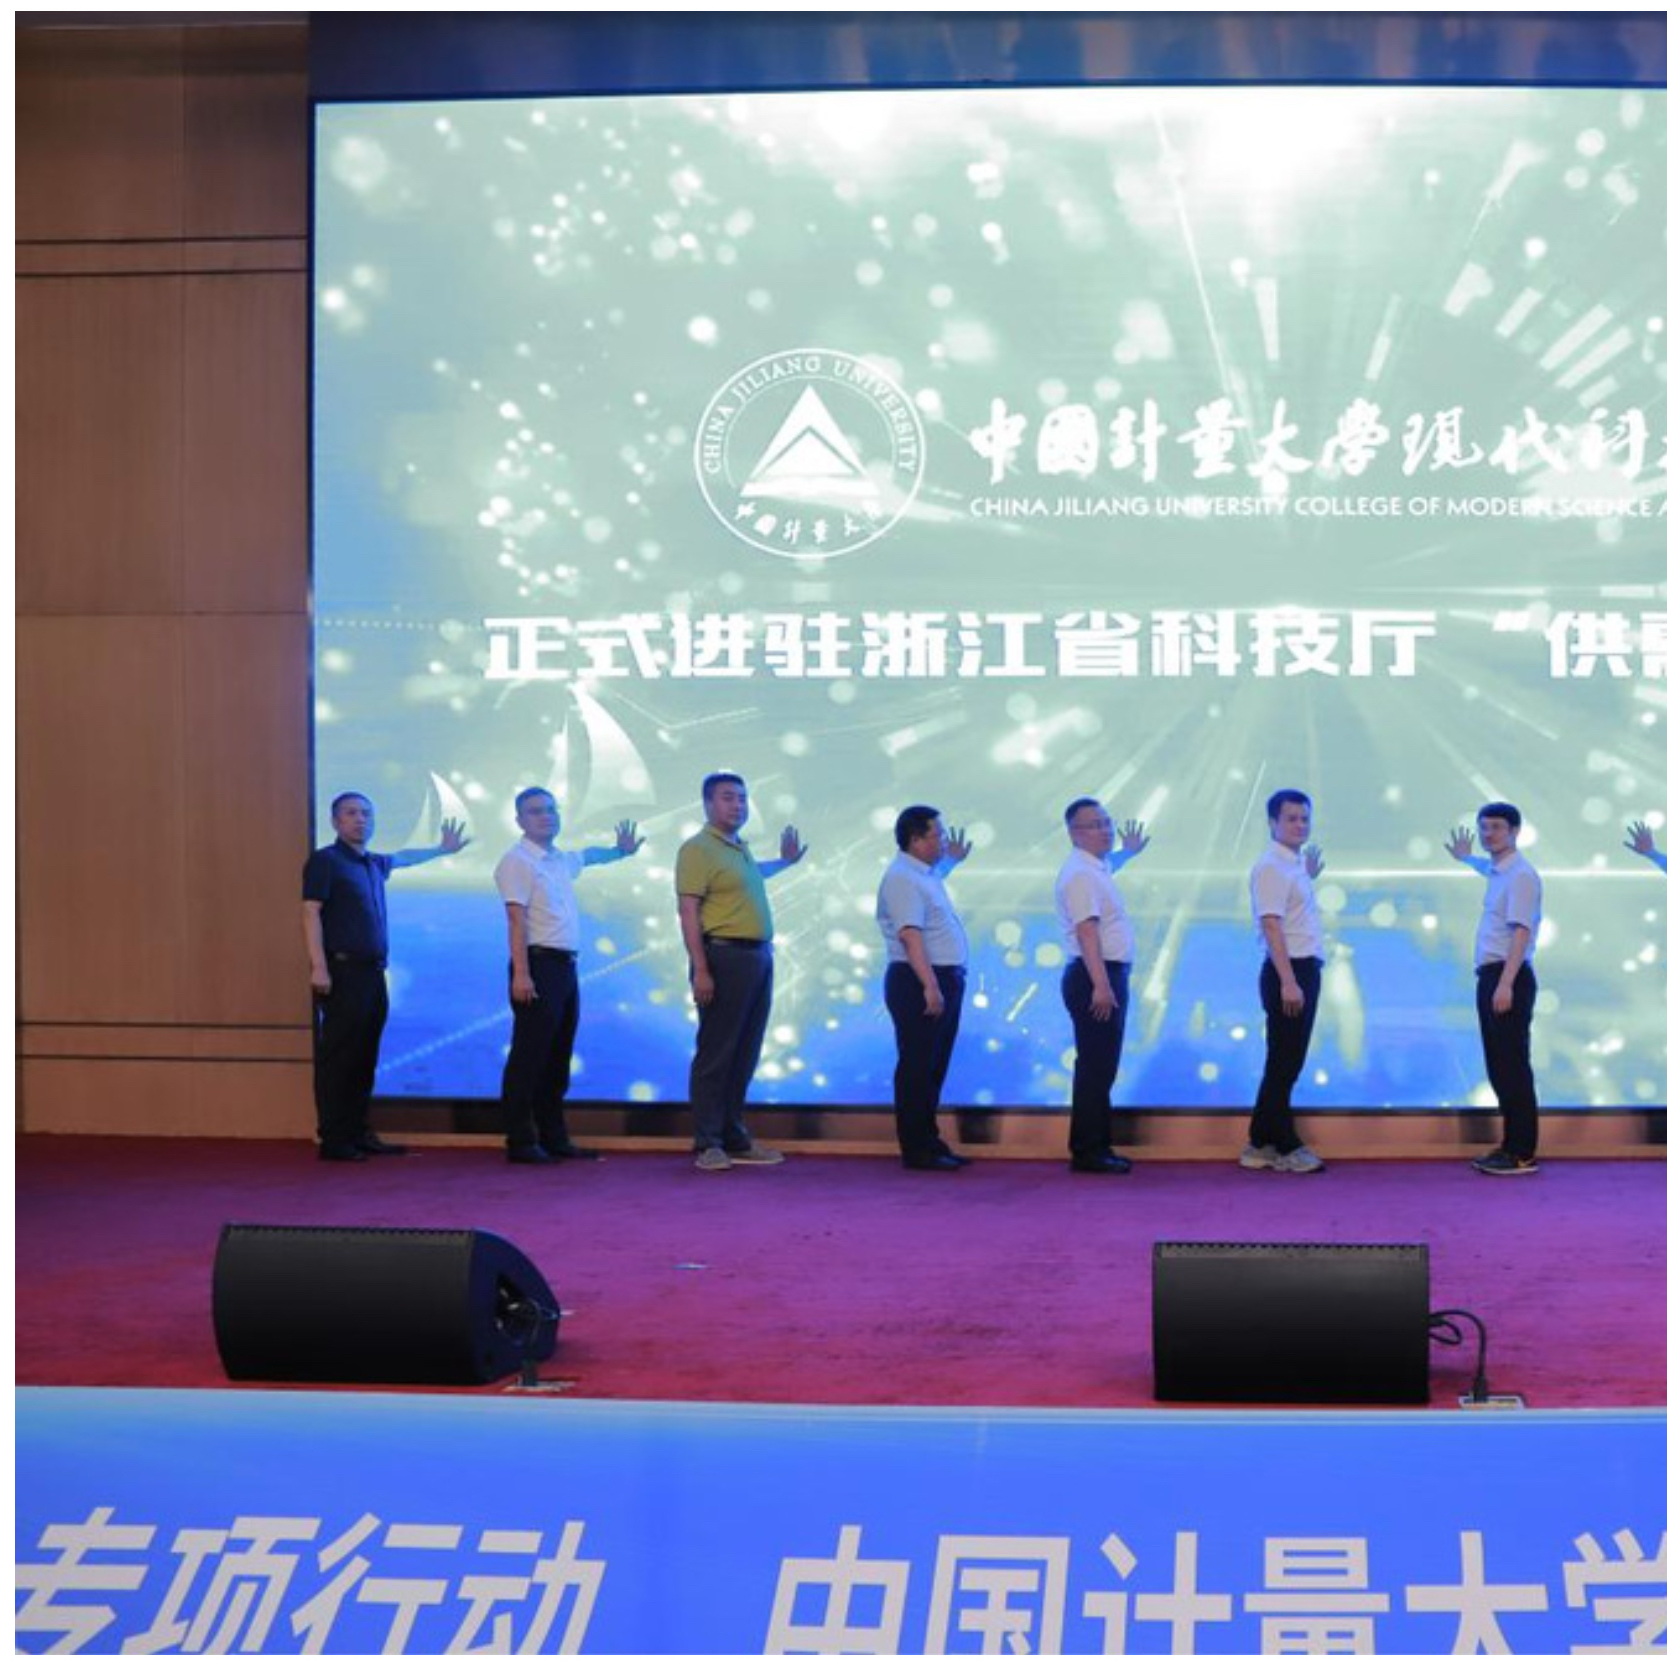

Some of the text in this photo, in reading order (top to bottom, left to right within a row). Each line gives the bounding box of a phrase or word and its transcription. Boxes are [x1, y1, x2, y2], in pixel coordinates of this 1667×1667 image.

[970, 496, 1048, 517] CHINA
[1053, 496, 1149, 517] JILIANG
[1155, 496, 1289, 517] UNIVERSITY
[1294, 496, 1403, 518] COLLEGE
[1407, 496, 1441, 518] OF
[1446, 496, 1554, 518] MODERN
[1559, 497, 1653, 520] SCIENCE
[15, 1506, 607, 1655] 专项行动
